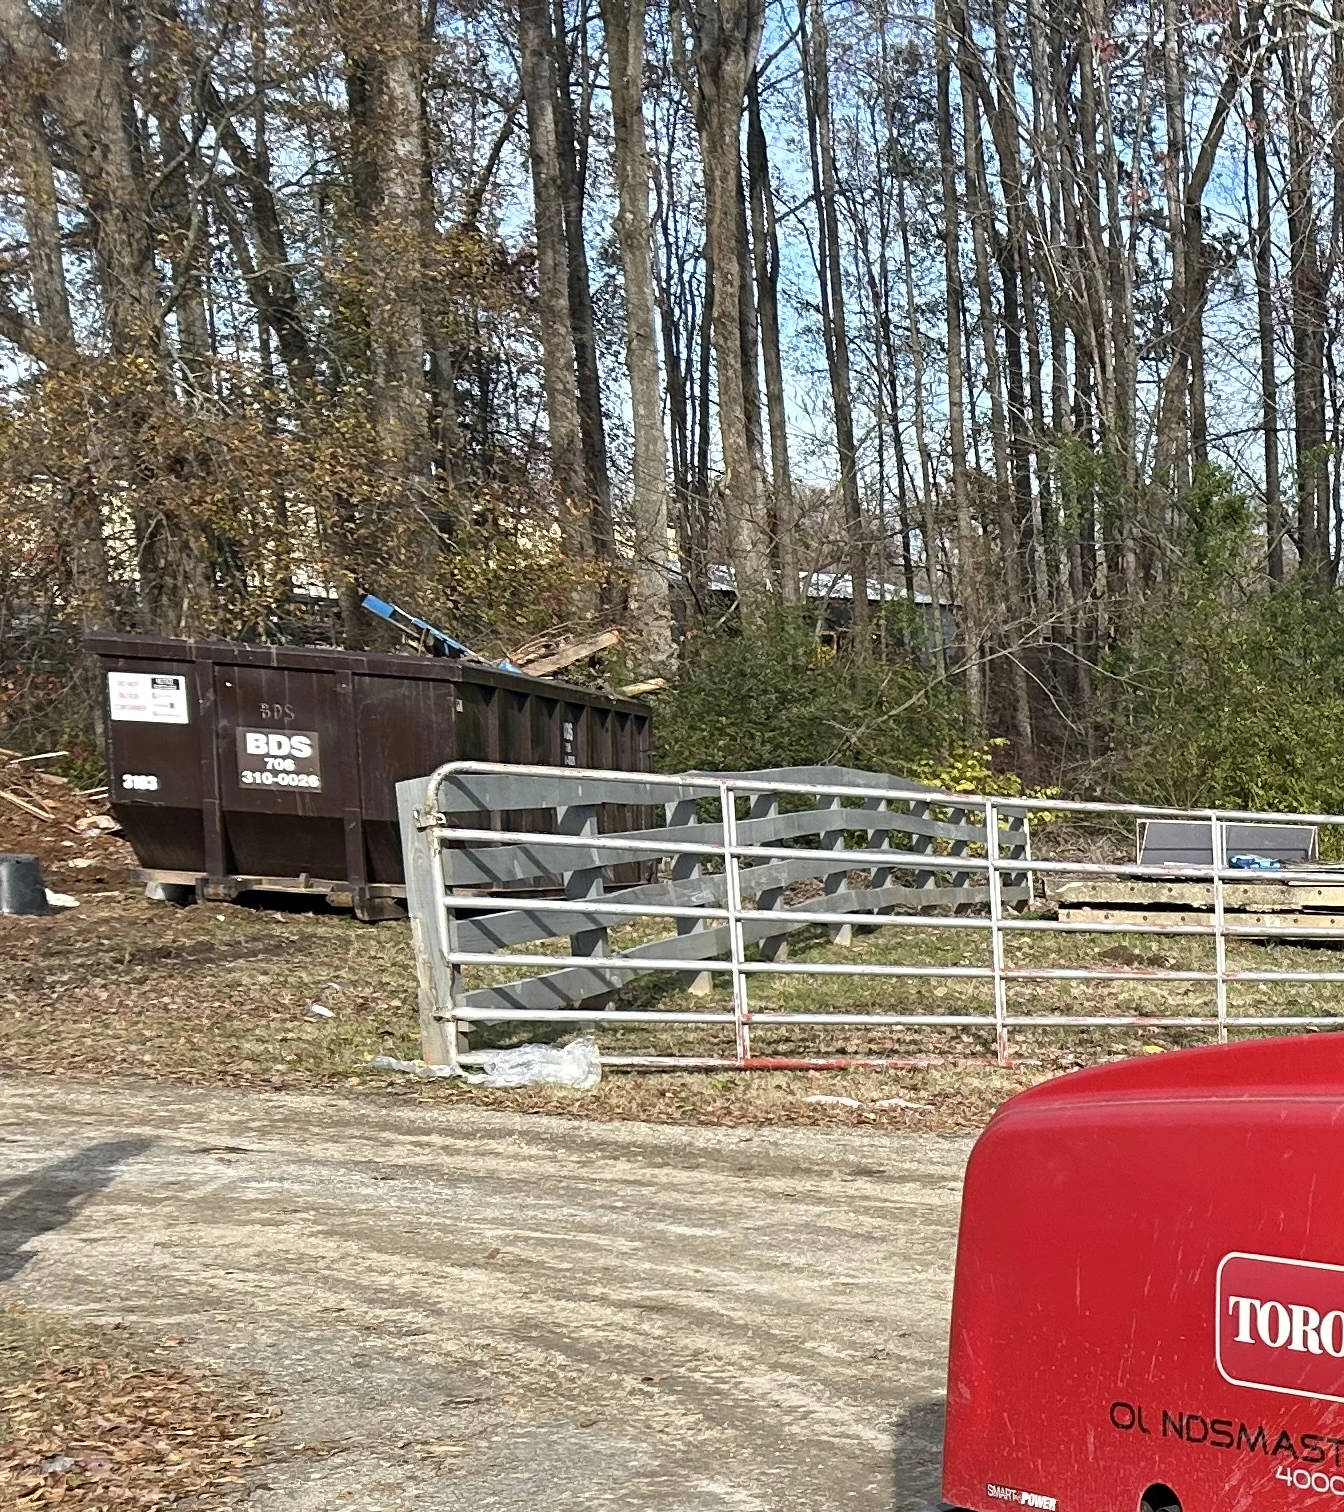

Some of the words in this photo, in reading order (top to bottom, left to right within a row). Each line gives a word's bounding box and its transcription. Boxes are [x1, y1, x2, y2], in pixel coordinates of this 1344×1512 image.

[259, 702, 296, 721] BDS
[245, 732, 312, 758] BDS
[264, 758, 295, 771] 706
[987, 1484, 1016, 1501] SMART
[1020, 1491, 1057, 1511] POWER
